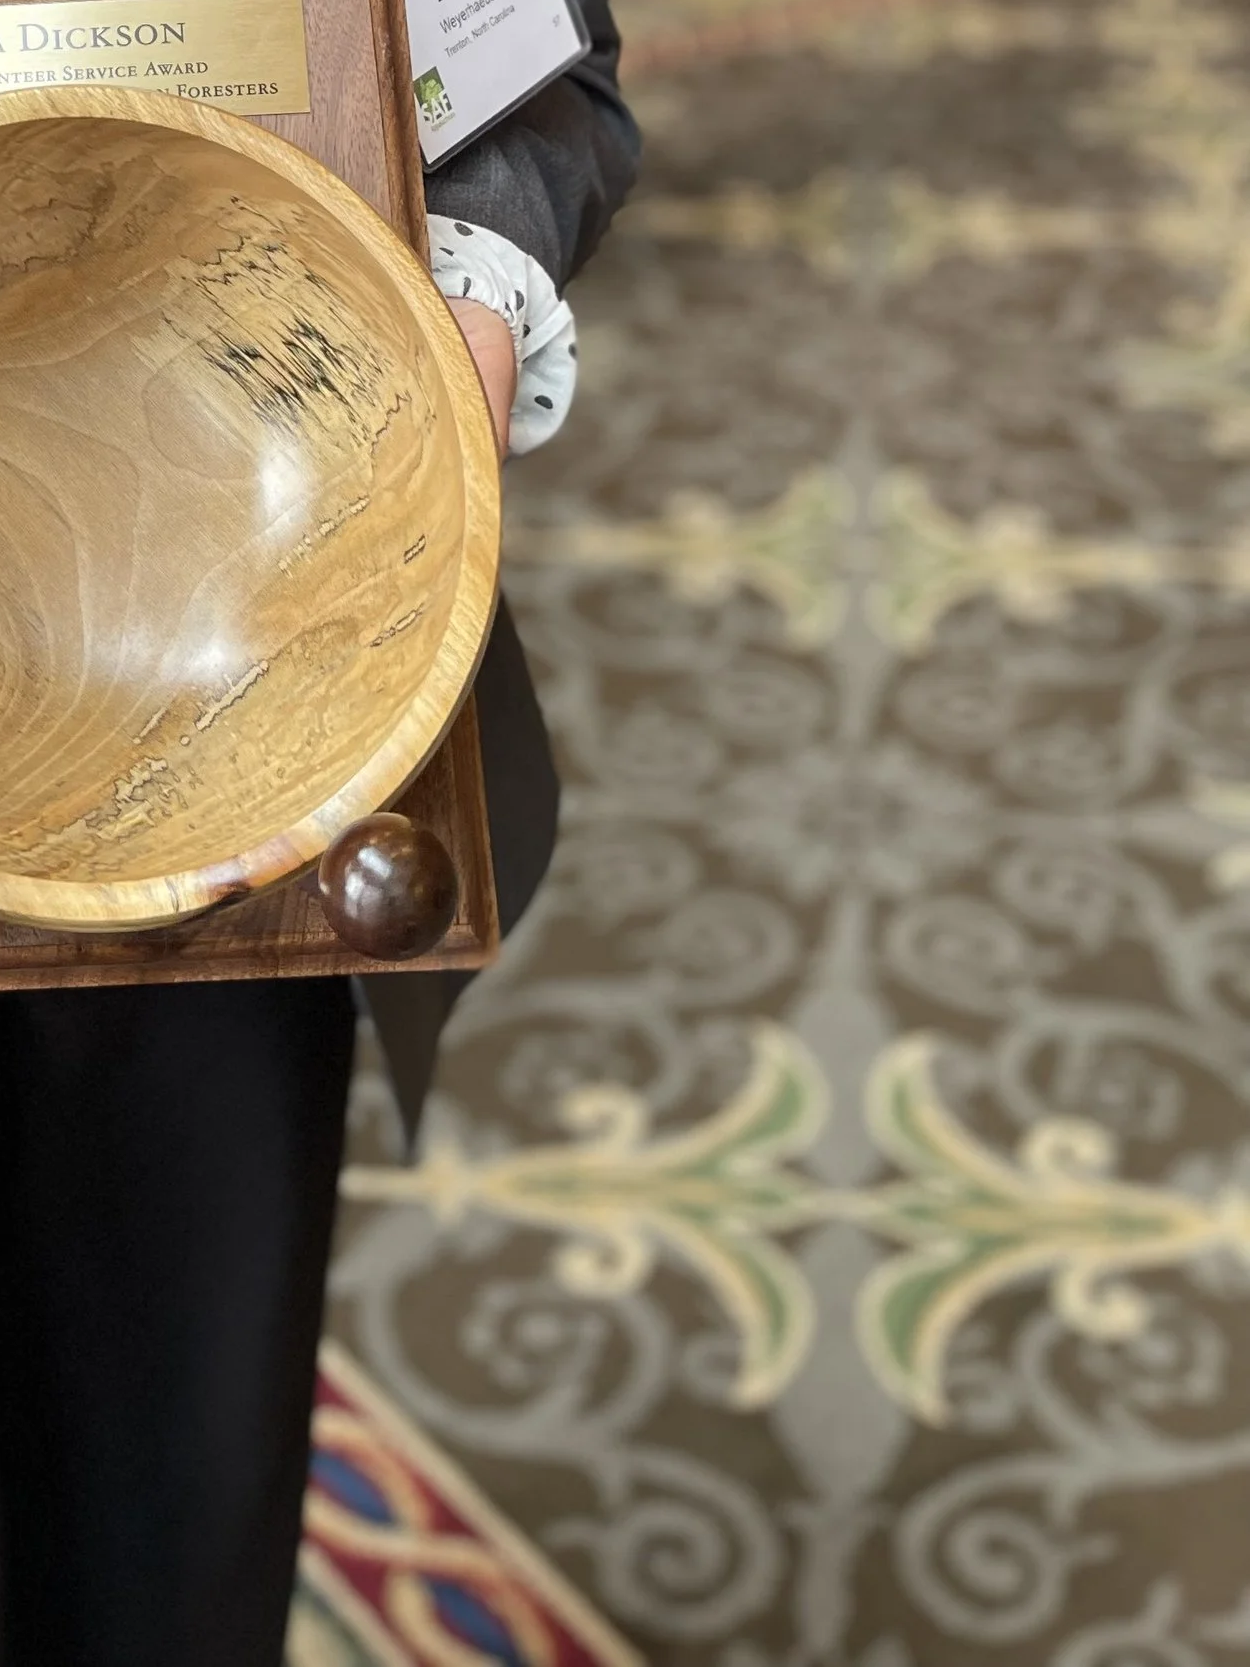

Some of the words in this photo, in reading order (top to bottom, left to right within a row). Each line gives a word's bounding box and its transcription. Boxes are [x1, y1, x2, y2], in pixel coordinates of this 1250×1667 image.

[17, 22, 186, 52] DICKSON
[62, 64, 138, 81] SERVICE
[144, 61, 209, 77] AWARD
[175, 81, 279, 99] FORESTERS
[422, 91, 451, 125] SAF
